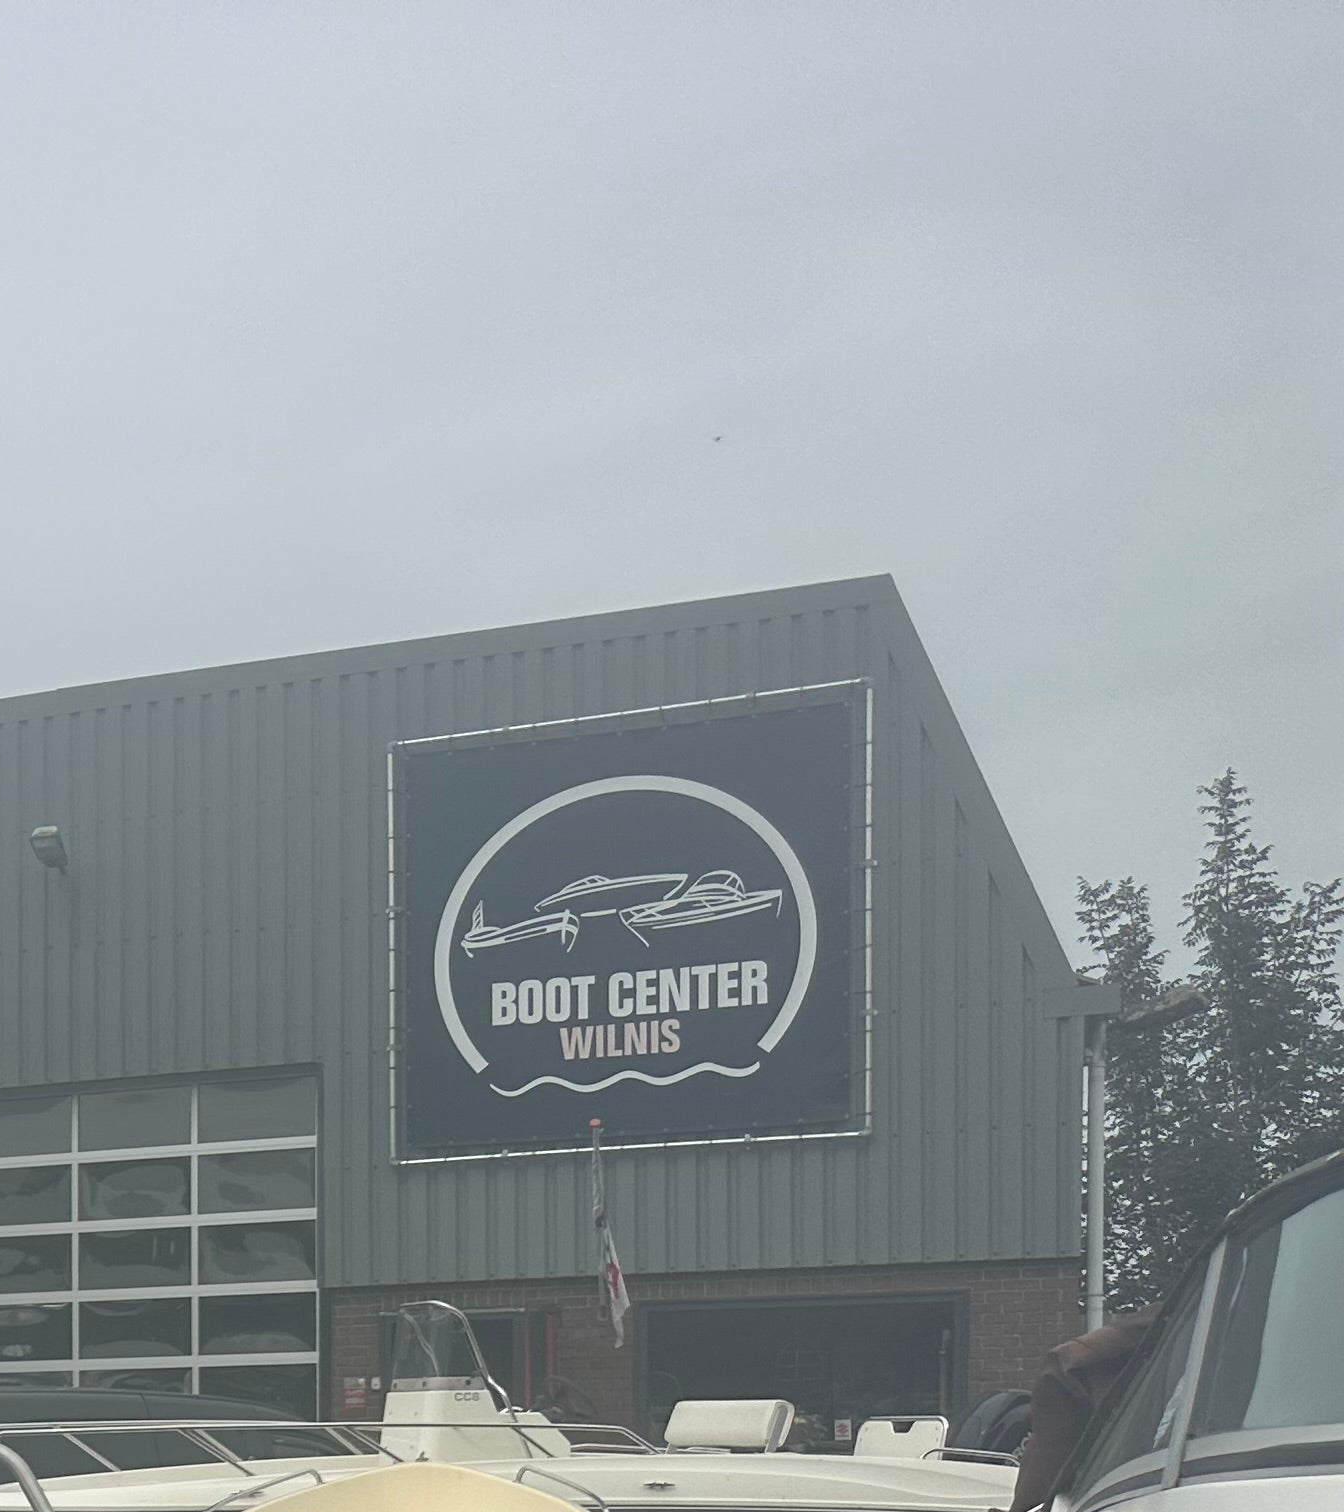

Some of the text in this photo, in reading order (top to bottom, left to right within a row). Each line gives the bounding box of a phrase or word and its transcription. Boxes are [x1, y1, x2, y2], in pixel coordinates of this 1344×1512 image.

[491, 960, 769, 1026] BOOT CENTER
[559, 1018, 681, 1061] WILNIS
